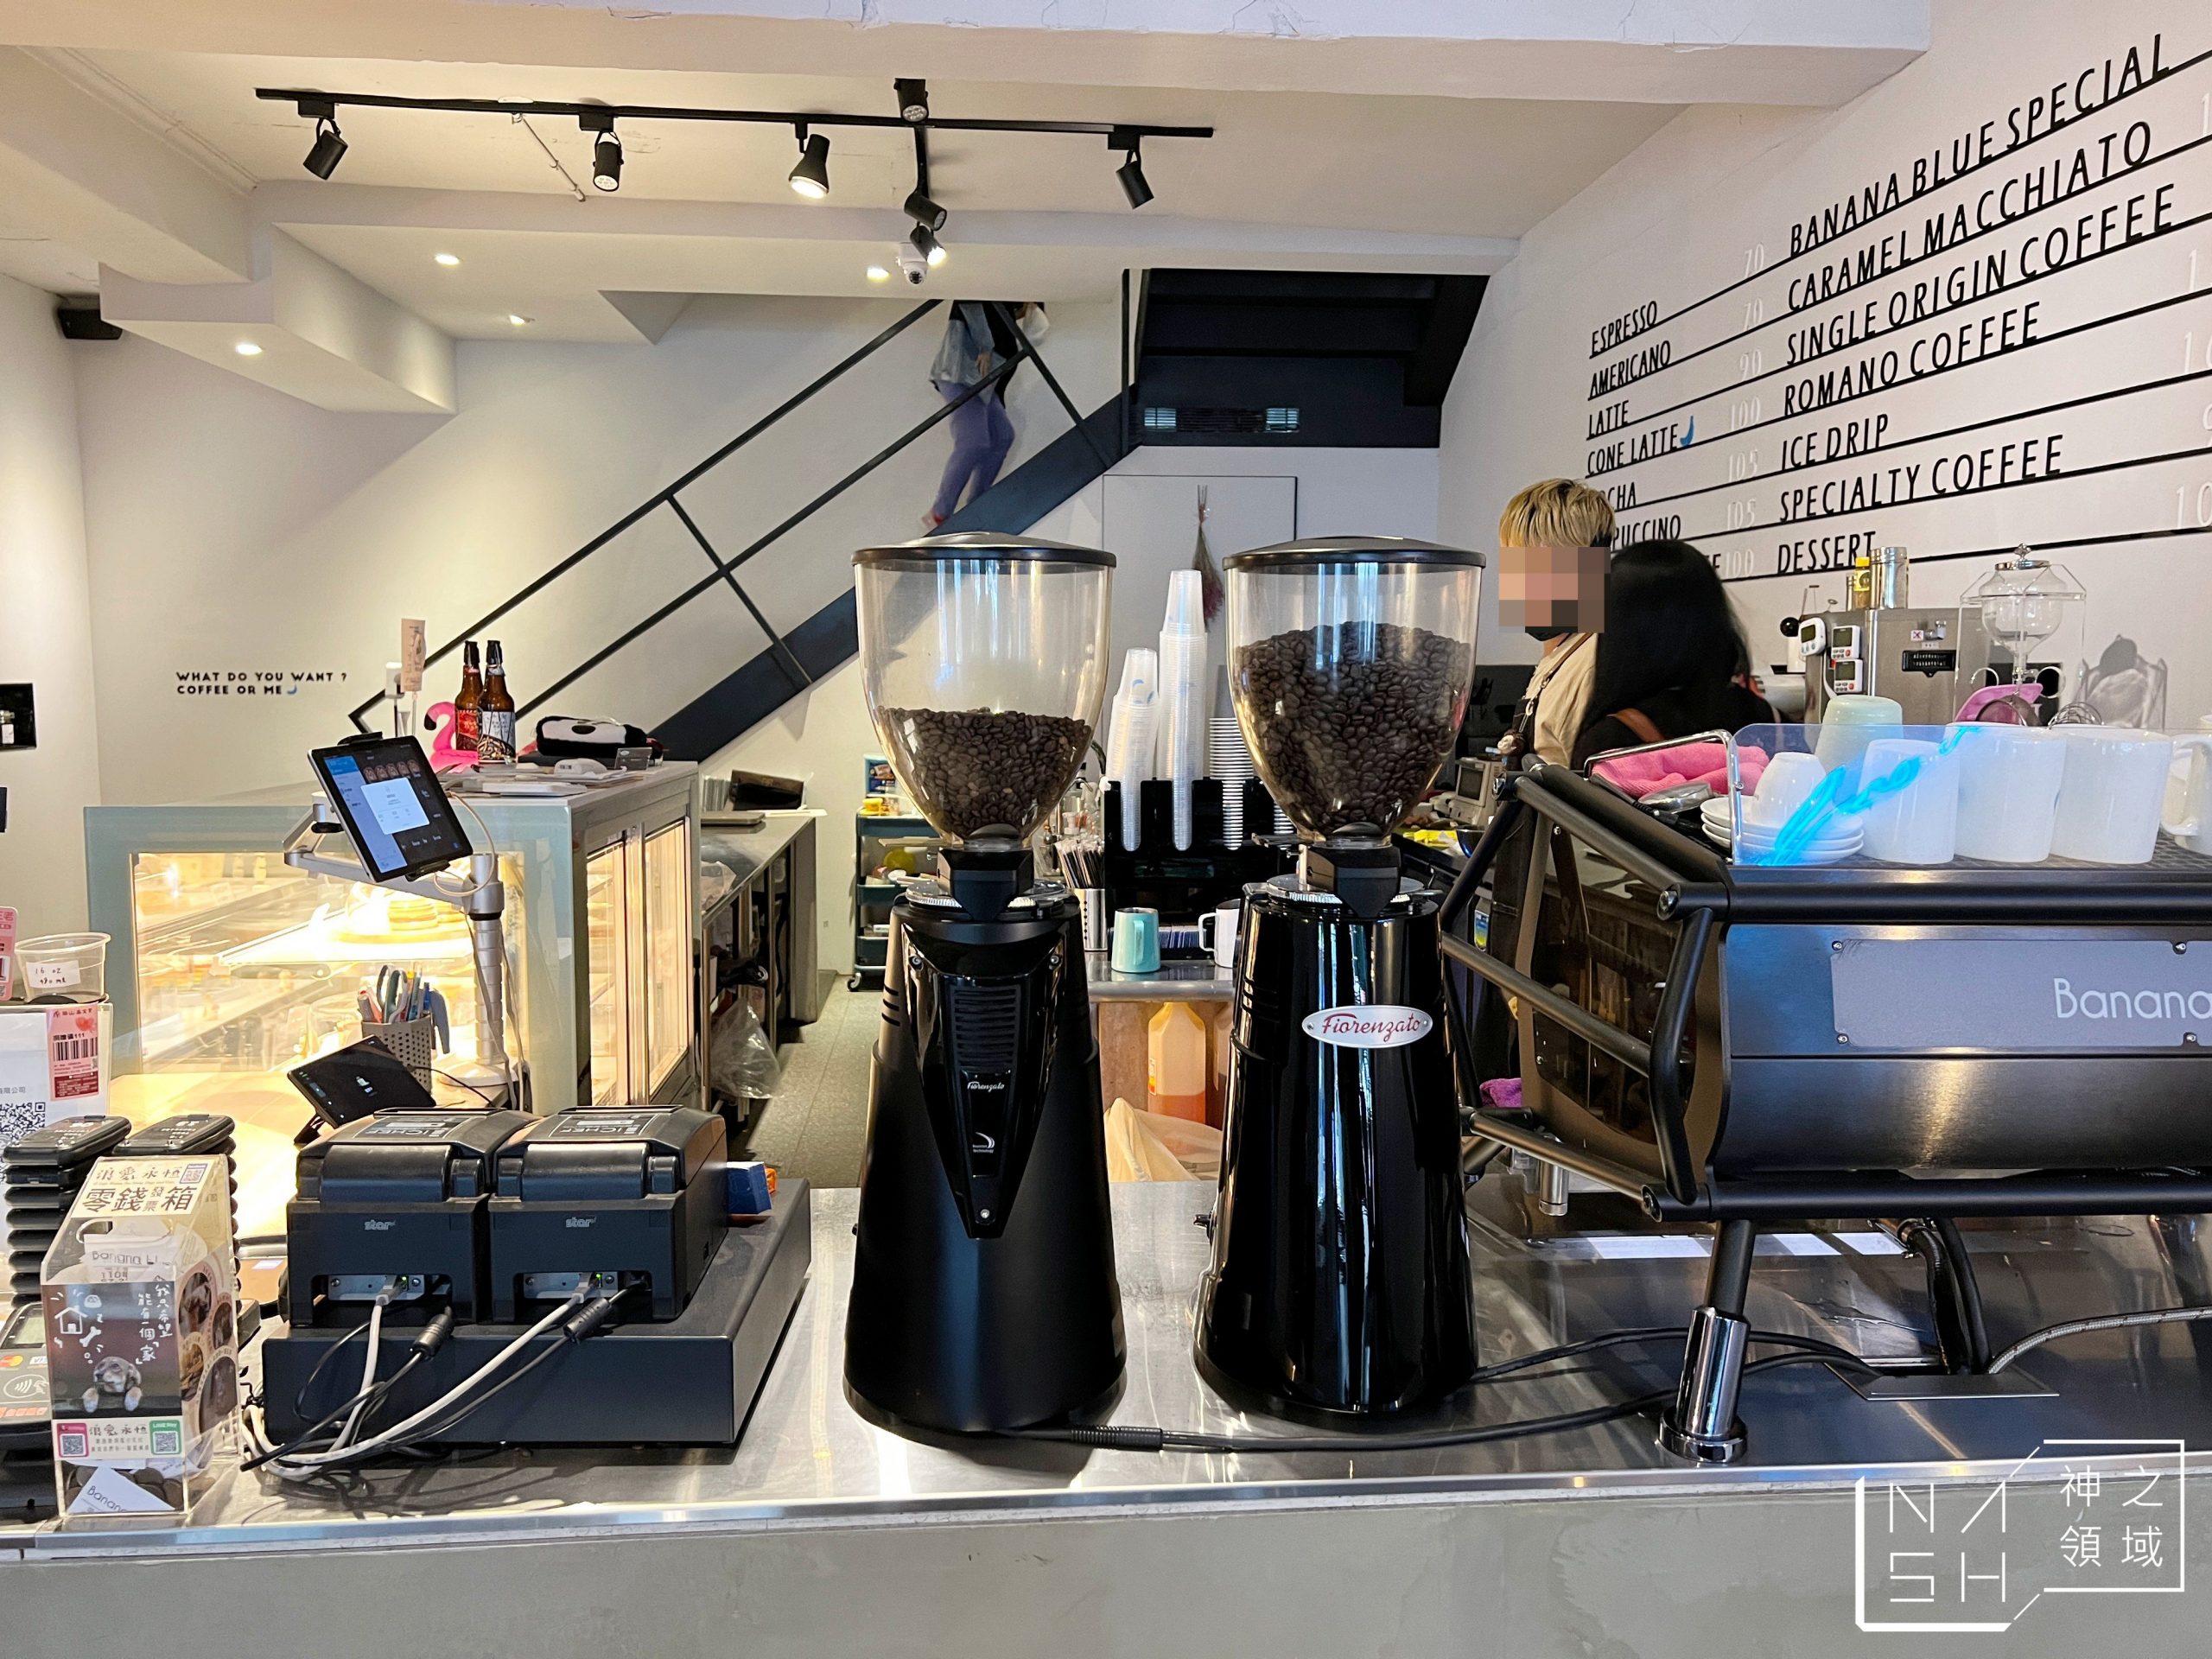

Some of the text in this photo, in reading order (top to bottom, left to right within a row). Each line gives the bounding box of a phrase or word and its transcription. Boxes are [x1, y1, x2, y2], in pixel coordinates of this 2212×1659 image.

[1790, 33, 2170, 257] BANANA BLUE SPECIAL
[1789, 121, 2151, 311] CARAMEL MACCHIATO
[1744, 244, 1764, 279] 70
[1787, 183, 2174, 364] SINGLE ORIGIN COFFEE
[1592, 300, 1657, 356] ESPRESSO
[1743, 298, 1764, 332] 70
[1590, 340, 1671, 398] AMERICANO
[1739, 349, 1762, 382] 90
[1784, 301, 2040, 416] ROMANO COFFEE
[1588, 400, 1630, 439] LATTE
[1731, 397, 1761, 431] 100
[1587, 423, 1679, 475] CONE LATTE
[1782, 413, 1889, 471] ICE DRIP
[1729, 448, 1758, 483] 105
[1780, 435, 2063, 523] SPECIALTY COFFEE
[1727, 499, 1757, 531] 105
[1725, 549, 1754, 578] 100
[1777, 531, 1876, 575] DESSERT
[176, 672, 347, 682] WHAT DO YOU WANT ?
[177, 685, 282, 695] COFFEE OR ME
[1321, 1013, 1421, 1042] Fiorenzato
[967, 1081, 1005, 1092] Fiorenzato
[364, 1219, 390, 1230] star
[565, 1217, 592, 1228] star
